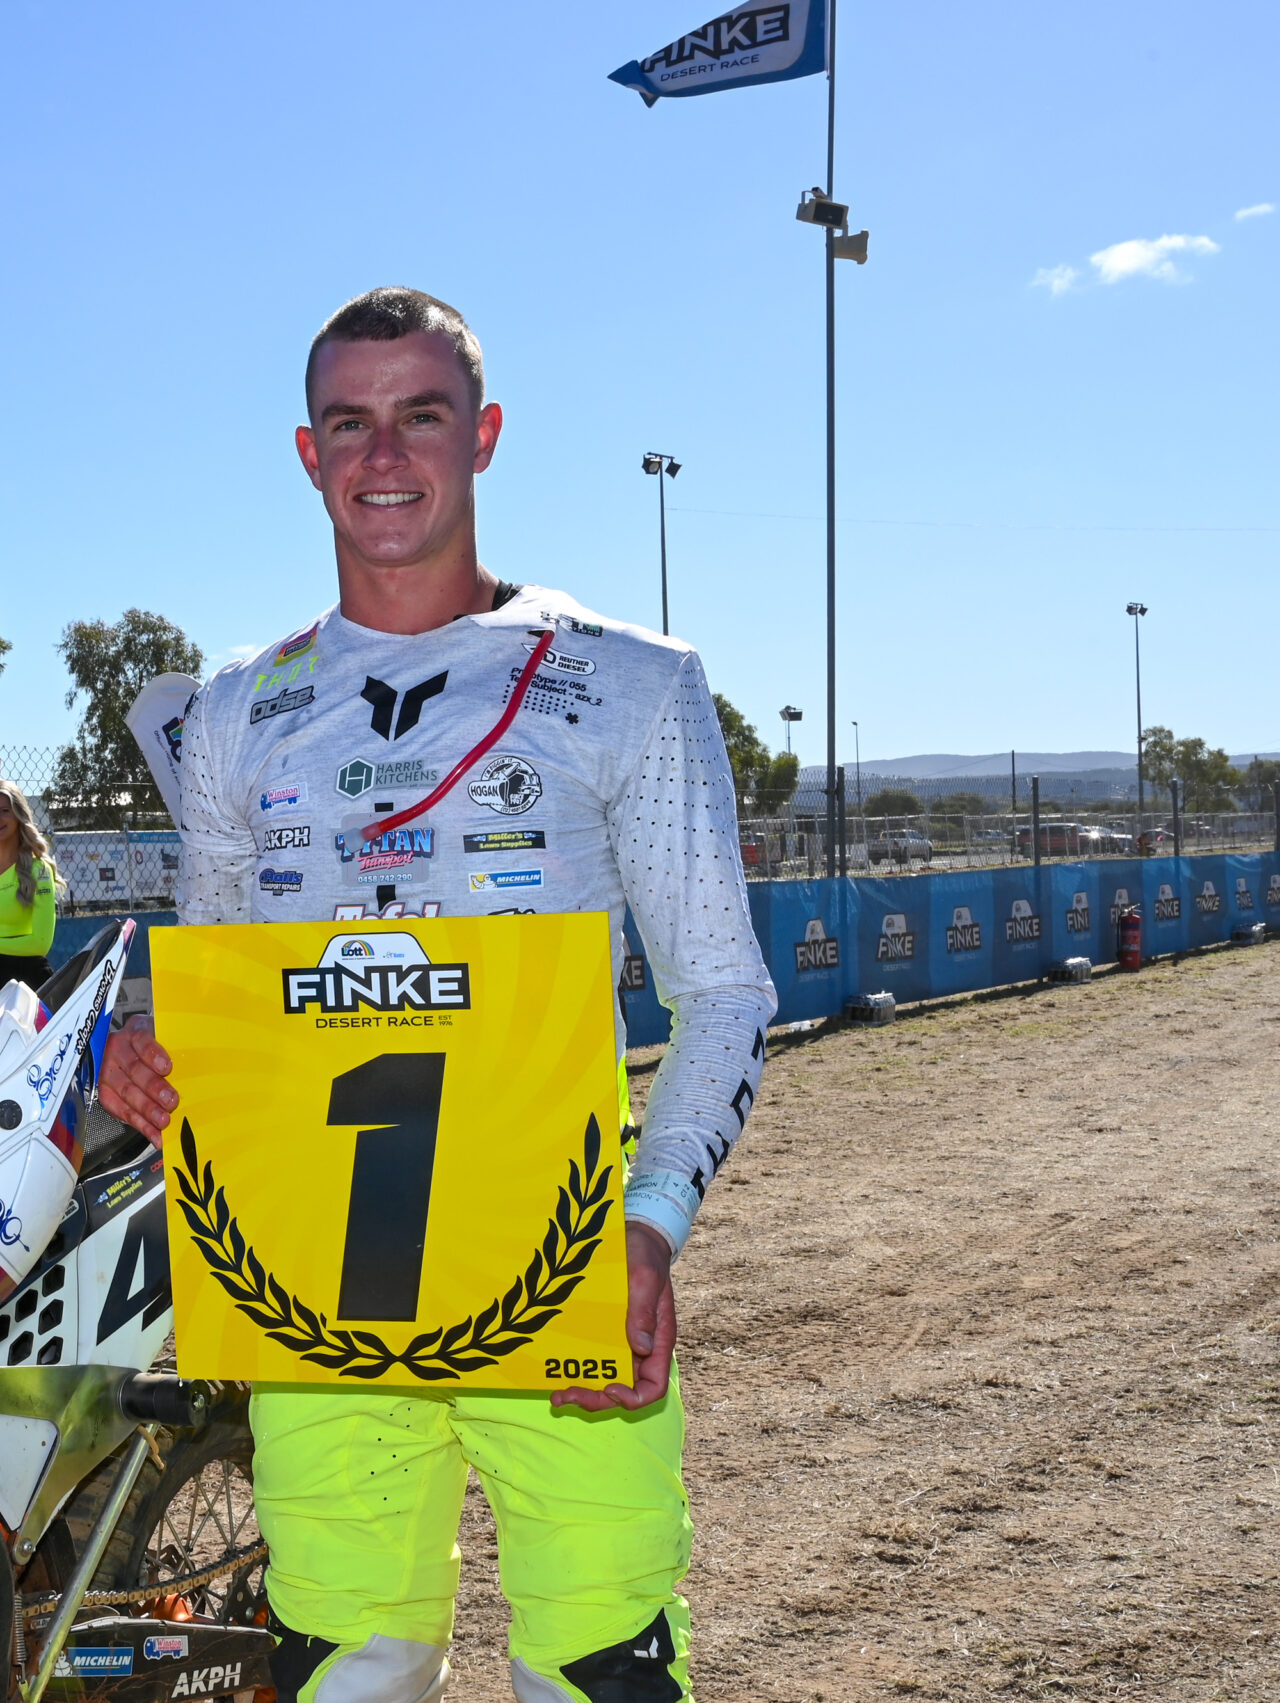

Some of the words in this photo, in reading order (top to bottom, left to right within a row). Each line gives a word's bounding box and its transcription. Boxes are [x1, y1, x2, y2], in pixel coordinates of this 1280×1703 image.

[642, 11, 785, 72] FINKE
[660, 63, 714, 82] DESERT
[720, 54, 759, 70] RACE
[557, 661, 587, 673] DIESEL
[511, 667, 557, 685] Protype
[569, 681, 587, 692] 055
[530, 680, 567, 696] Subject
[376, 760, 423, 775] HARRIS
[375, 771, 438, 785] KITCHENS
[267, 786, 299, 798] Winston
[470, 785, 499, 797] HOGAN
[337, 828, 432, 857] TAN
[497, 874, 541, 883] MICHELIN
[946, 926, 981, 950] FINKE
[1006, 920, 1040, 941] FINKE
[341, 945, 363, 957] Lott
[288, 969, 464, 1008] FINKE
[315, 1017, 382, 1029] DESERT
[388, 1015, 434, 1027] RACE
[325, 1051, 447, 1323] 1
[97, 1196, 174, 1346] 4
[545, 1357, 618, 1381] 2025
[156, 1638, 182, 1649] Winston
[73, 1654, 132, 1667] MICHELIN
[171, 1662, 242, 1699] AKPH
